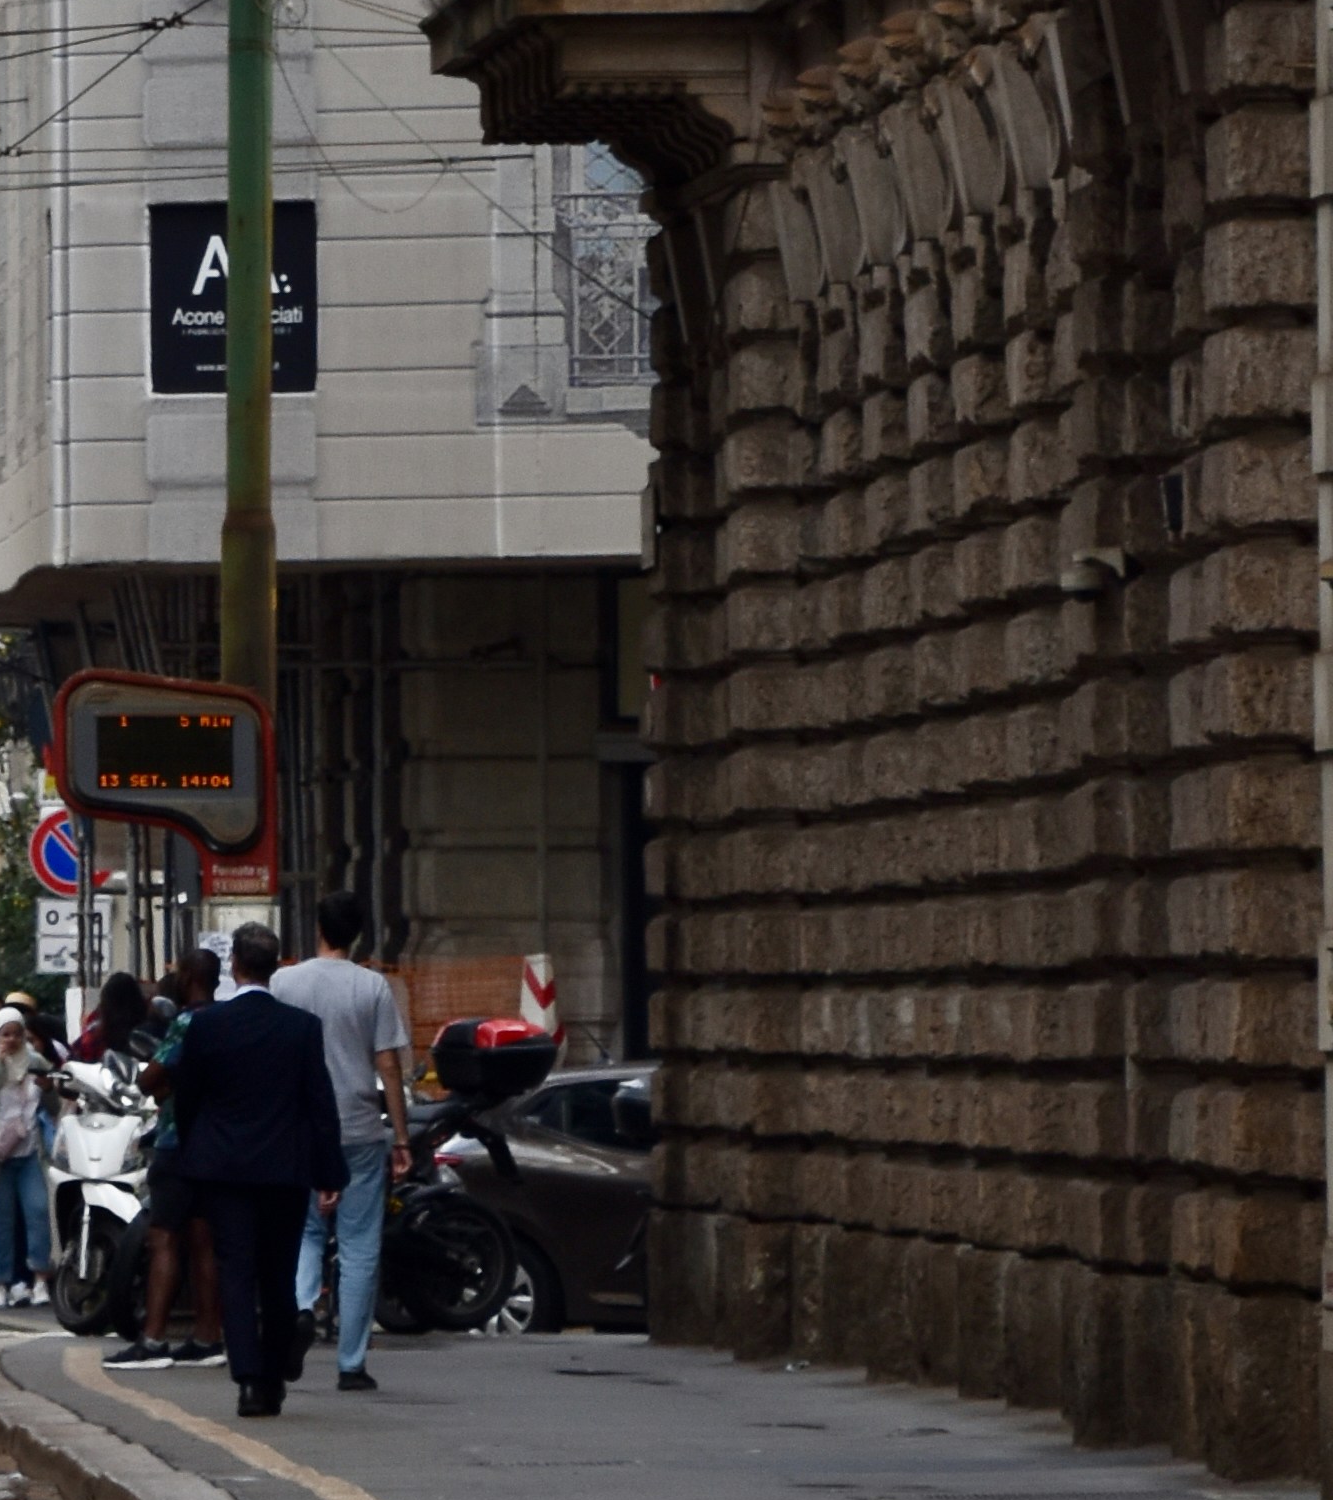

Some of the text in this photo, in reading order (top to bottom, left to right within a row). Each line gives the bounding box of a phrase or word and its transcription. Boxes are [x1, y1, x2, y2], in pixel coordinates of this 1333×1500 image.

[171, 305, 303, 326] Acone ciati
[200, 715, 231, 727] MIN
[100, 774, 230, 788] 13 SET. 14:04
